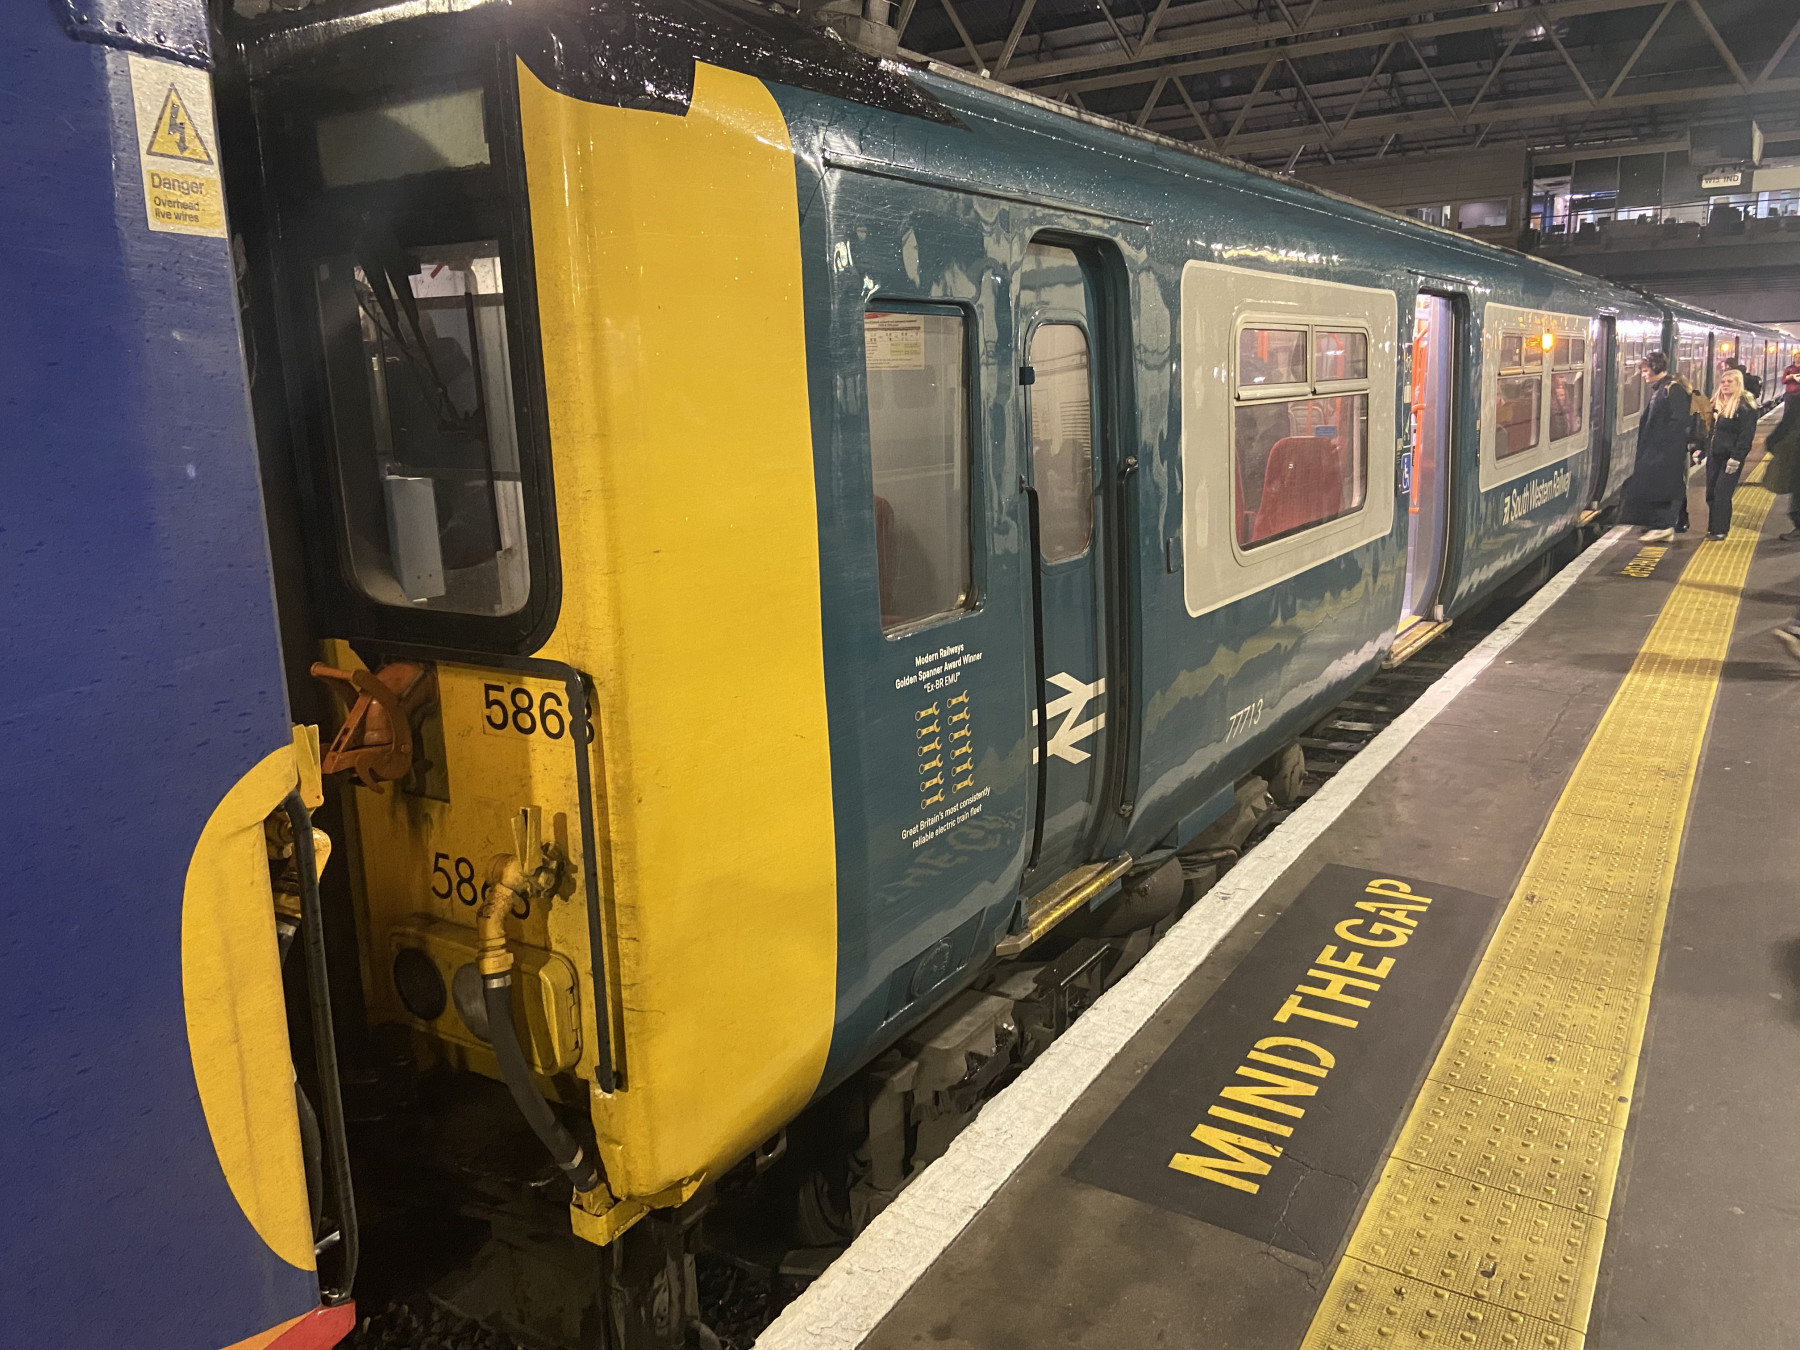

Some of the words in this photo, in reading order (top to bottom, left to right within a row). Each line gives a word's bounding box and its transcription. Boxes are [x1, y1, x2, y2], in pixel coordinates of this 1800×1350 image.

[151, 173, 205, 195] Danger
[1723, 174, 1739, 182] IND
[153, 196, 200, 211] Overhead
[155, 208, 172, 220] live
[174, 210, 200, 223] wires
[1510, 483, 1529, 522] South
[895, 675, 918, 689] Golden
[918, 665, 943, 682] Spanner
[943, 657, 962, 672] Award
[962, 652, 983, 665] Winner
[915, 653, 939, 667] Modern
[939, 643, 965, 659] Railways
[1226, 698, 1264, 743] 77713
[901, 824, 919, 840] Great
[919, 811, 944, 831] Britain's
[944, 803, 960, 817] most
[959, 785, 991, 809] consistently
[912, 830, 935, 849] reliable
[935, 818, 957, 836] electric
[956, 811, 970, 824] train
[970, 803, 983, 817] fleet
[431, 852, 531, 920] 58
[1168, 1036, 1336, 1194] MIND
[1272, 944, 1396, 1029] THE
[1334, 878, 1433, 948] GAP
